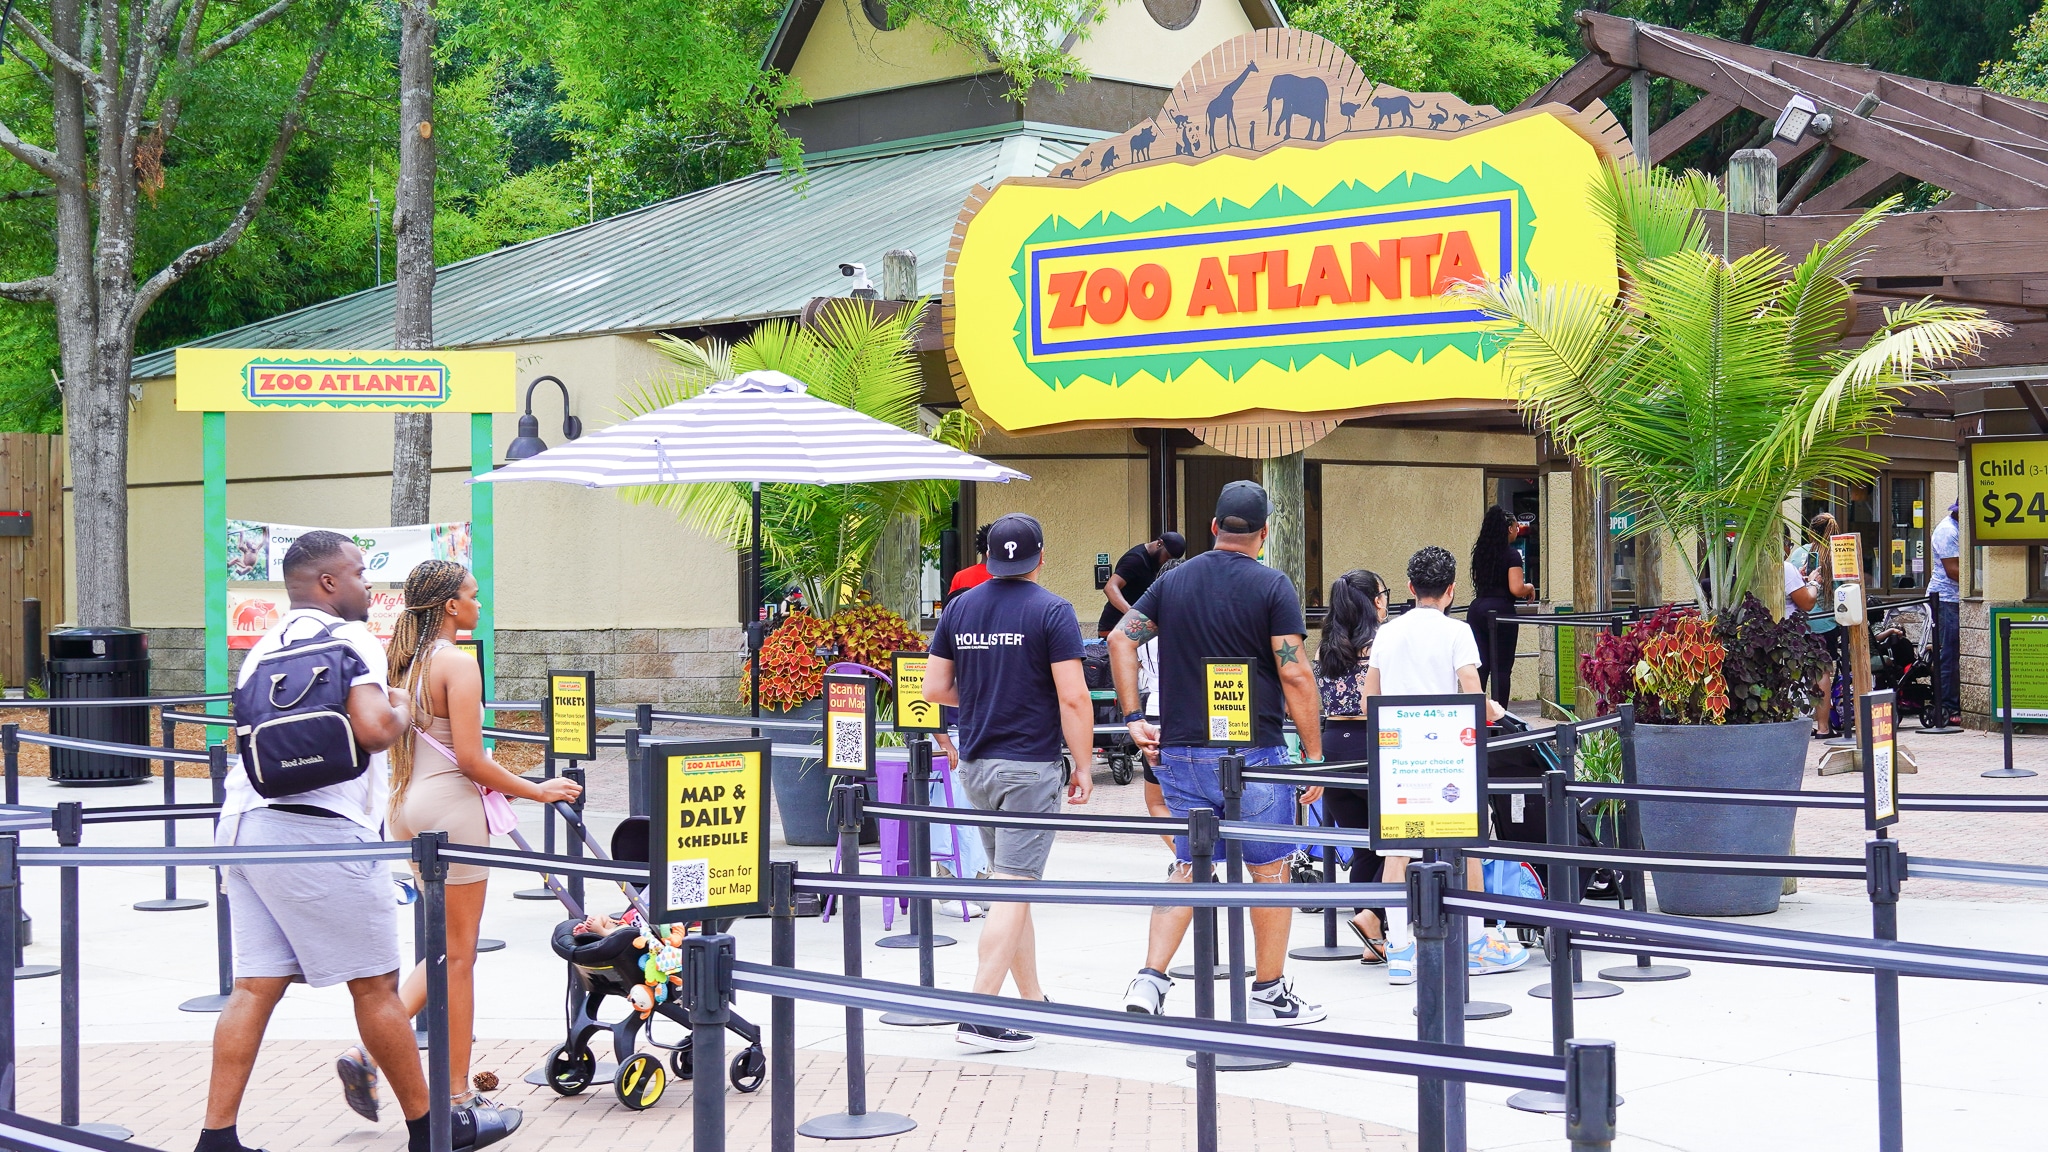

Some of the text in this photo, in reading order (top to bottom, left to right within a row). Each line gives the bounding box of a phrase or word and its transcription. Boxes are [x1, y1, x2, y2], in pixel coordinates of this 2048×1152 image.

[1048, 230, 1484, 329] ZOO ATLANTA
[259, 373, 437, 392] ZOO ATLANTA
[1976, 418, 1983, 436] 4
[1979, 459, 2025, 477] Child
[1982, 489, 2048, 528] $24
[1004, 541, 1018, 559] P
[369, 592, 406, 611] Nigh
[954, 632, 1023, 646] HOLLISTER
[830, 682, 853, 695] Scan
[1213, 680, 1244, 689] MAP &
[555, 696, 585, 706] TICKETS
[1214, 690, 1245, 701] DAILY
[829, 698, 846, 708] our
[1396, 709, 1458, 718] Save 44% at
[1228, 720, 1249, 728] Scan for
[1238, 729, 1249, 737] Map
[1871, 725, 1880, 738] ur
[686, 759, 742, 770] ZOO ATLANTA
[1392, 758, 1408, 766] Plus
[1456, 757, 1465, 765] of
[1392, 767, 1397, 775] 2
[680, 783, 746, 804] MAP &
[680, 805, 747, 828] DAILY
[677, 831, 748, 849] SCHEDULE
[708, 864, 753, 879] Scan for
[709, 882, 752, 897] our Map
